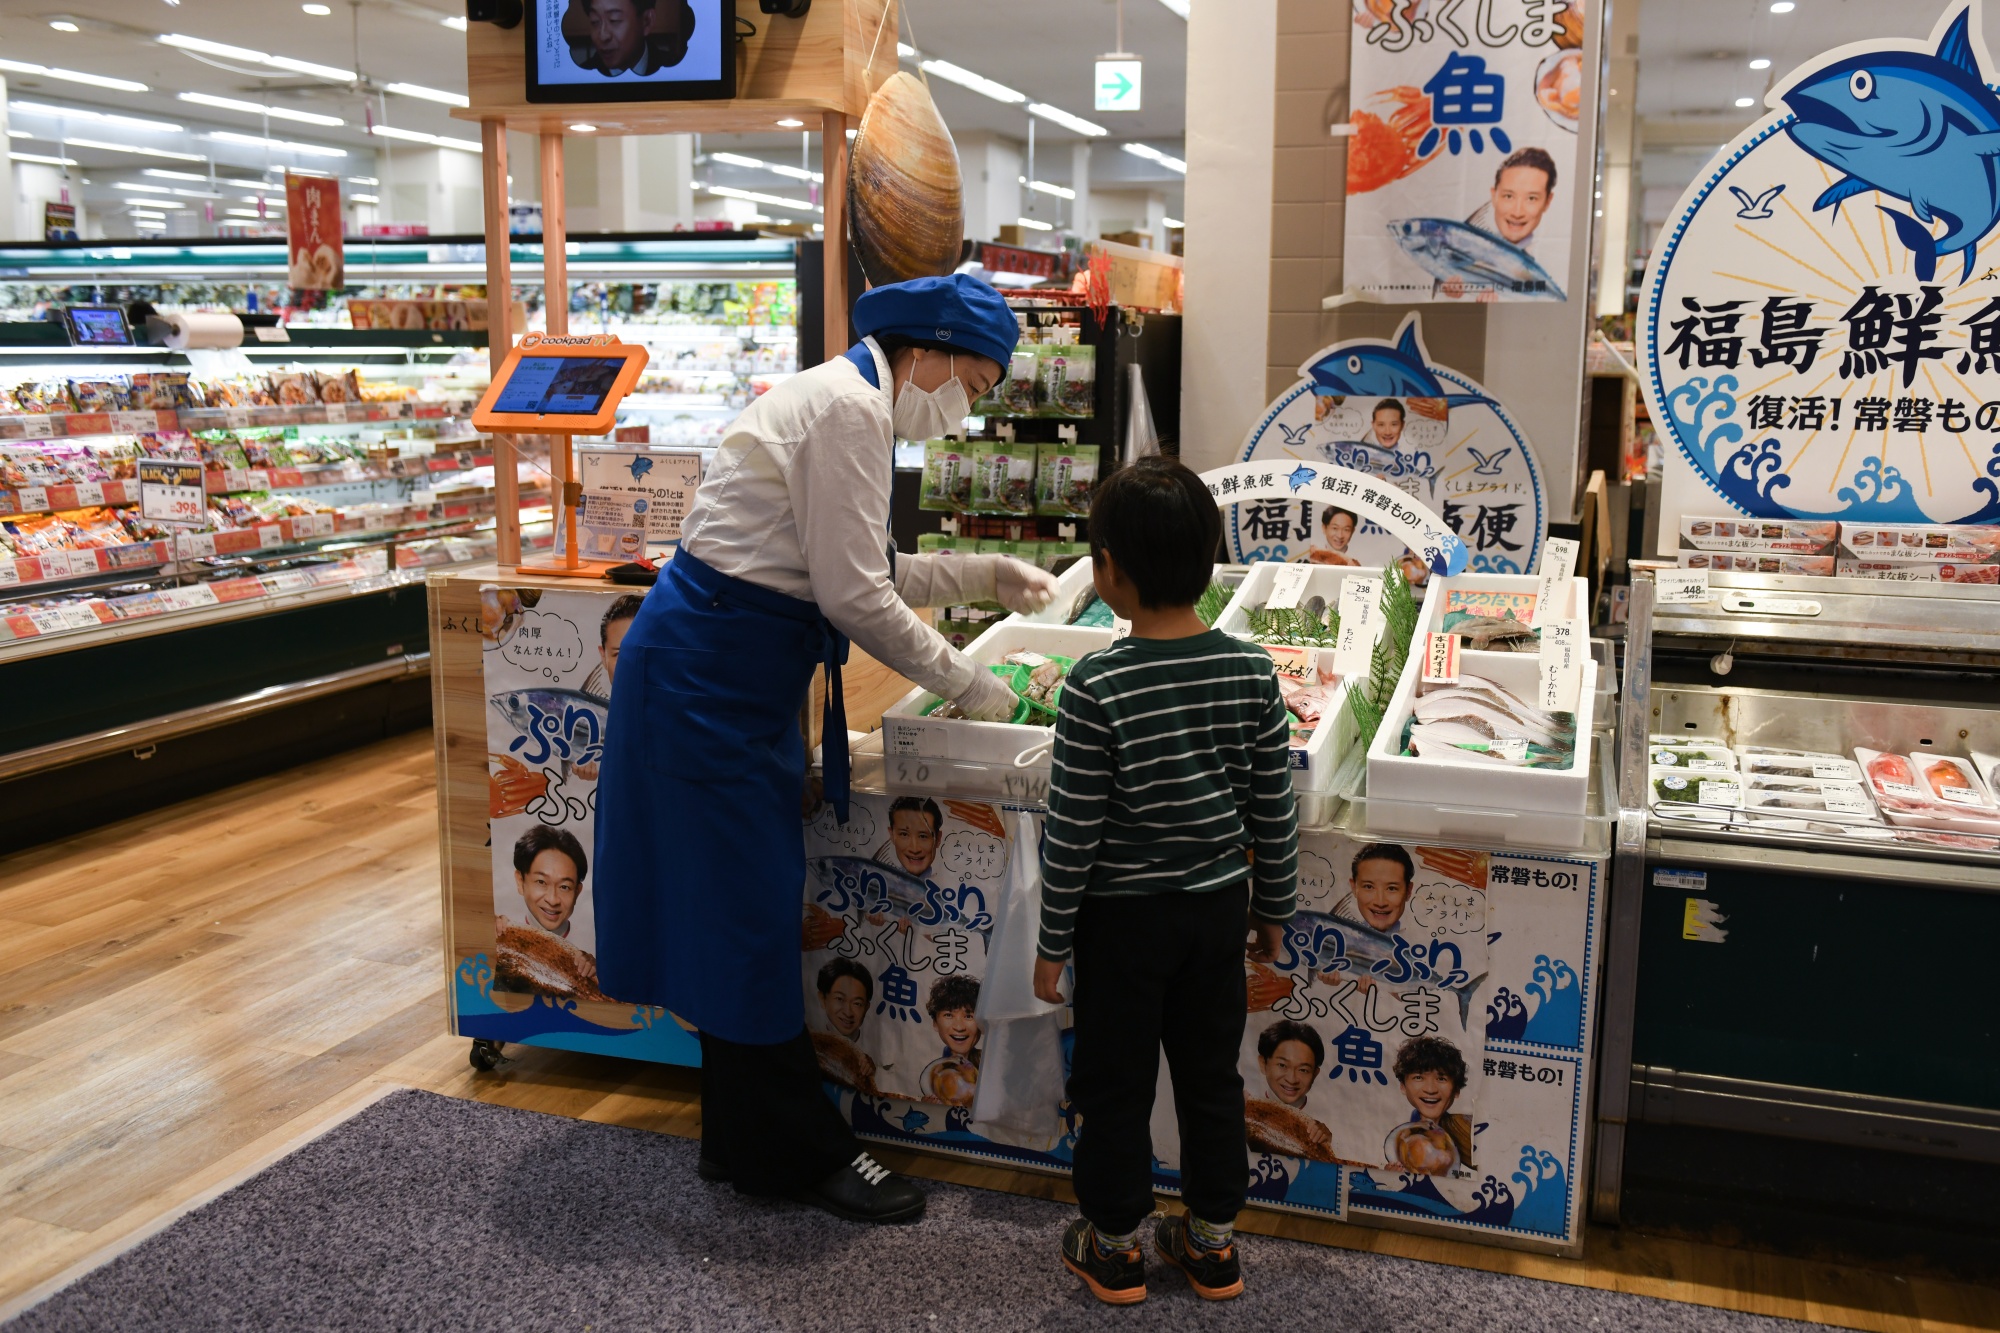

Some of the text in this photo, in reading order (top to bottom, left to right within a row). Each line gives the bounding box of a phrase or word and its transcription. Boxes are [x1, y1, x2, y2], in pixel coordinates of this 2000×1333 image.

[1367, 0, 1567, 52] ふくしま
[1417, 51, 1512, 156] 魚
[306, 185, 322, 243] 肉まん
[542, 336, 614, 346] cookpad TV
[1748, 395, 2000, 433] 復活! 常磐もの
[1384, 450, 1434, 477] ぷりっ
[1322, 476, 1357, 496] 復活!
[1362, 488, 1422, 530] 常磐もの!
[1890, 550, 1934, 558] まな板シート
[1356, 584, 1370, 594] 238
[1450, 591, 1530, 607] まとうだい
[518, 626, 542, 640] 肉厚
[514, 644, 571, 658] なんだもん!
[1547, 665, 1558, 706] むしかれい
[822, 822, 866, 836] なんだもん!
[954, 840, 996, 854] ふくしま
[954, 852, 995, 867] プライド
[1491, 865, 1578, 891] 常磐もの!
[817, 867, 992, 930] ぷりっ ぷりっ
[1426, 892, 1475, 906] ふくしま
[1426, 905, 1474, 920] プライド
[826, 914, 968, 975] ふくしま
[1273, 924, 1470, 988] ぷりっ ぷりっ
[876, 962, 922, 1023] 魚
[1271, 974, 1440, 1037] ふくしま
[1329, 1023, 1388, 1086] 魚
[1483, 1058, 1563, 1086] 常磐もの!
